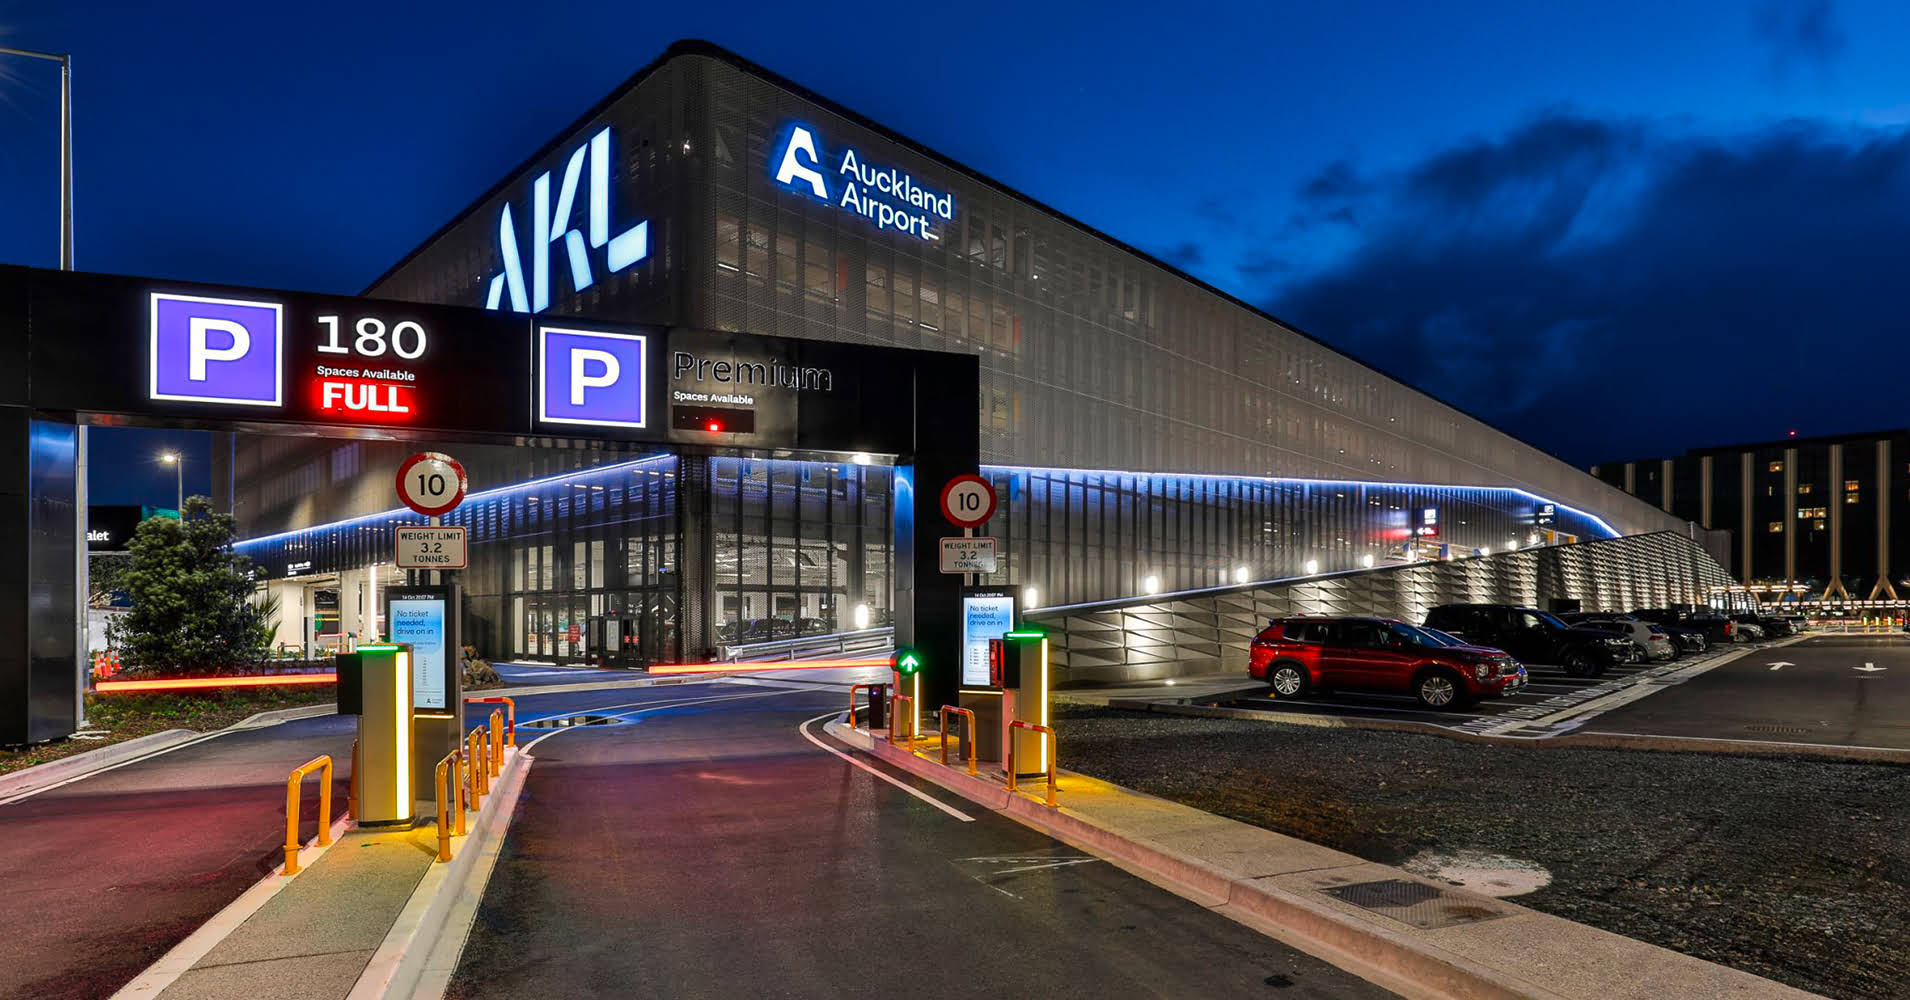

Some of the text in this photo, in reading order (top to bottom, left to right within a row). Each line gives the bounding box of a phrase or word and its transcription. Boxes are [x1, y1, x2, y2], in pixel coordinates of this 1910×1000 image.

[840, 149, 952, 220] Auckland
[840, 182, 939, 240] Airport
[486, 126, 648, 314] AKL
[317, 315, 427, 360] 180
[189, 316, 251, 381] P
[317, 365, 415, 381] Spaces Available
[571, 348, 620, 406] P
[674, 351, 832, 391] Premium
[323, 381, 409, 413] FULL
[674, 391, 754, 405] Spaces Available
[418, 474, 445, 496] 10
[958, 492, 980, 511] 10
[87, 530, 109, 541] alet
[400, 532, 462, 540] WEIGHT LIMIT
[421, 543, 442, 553] 3.2
[960, 551, 977, 560] 3.2
[413, 555, 450, 563] TONNES
[409, 609, 429, 617] ticket
[397, 619, 426, 627] needed,
[397, 627, 415, 635] drive
